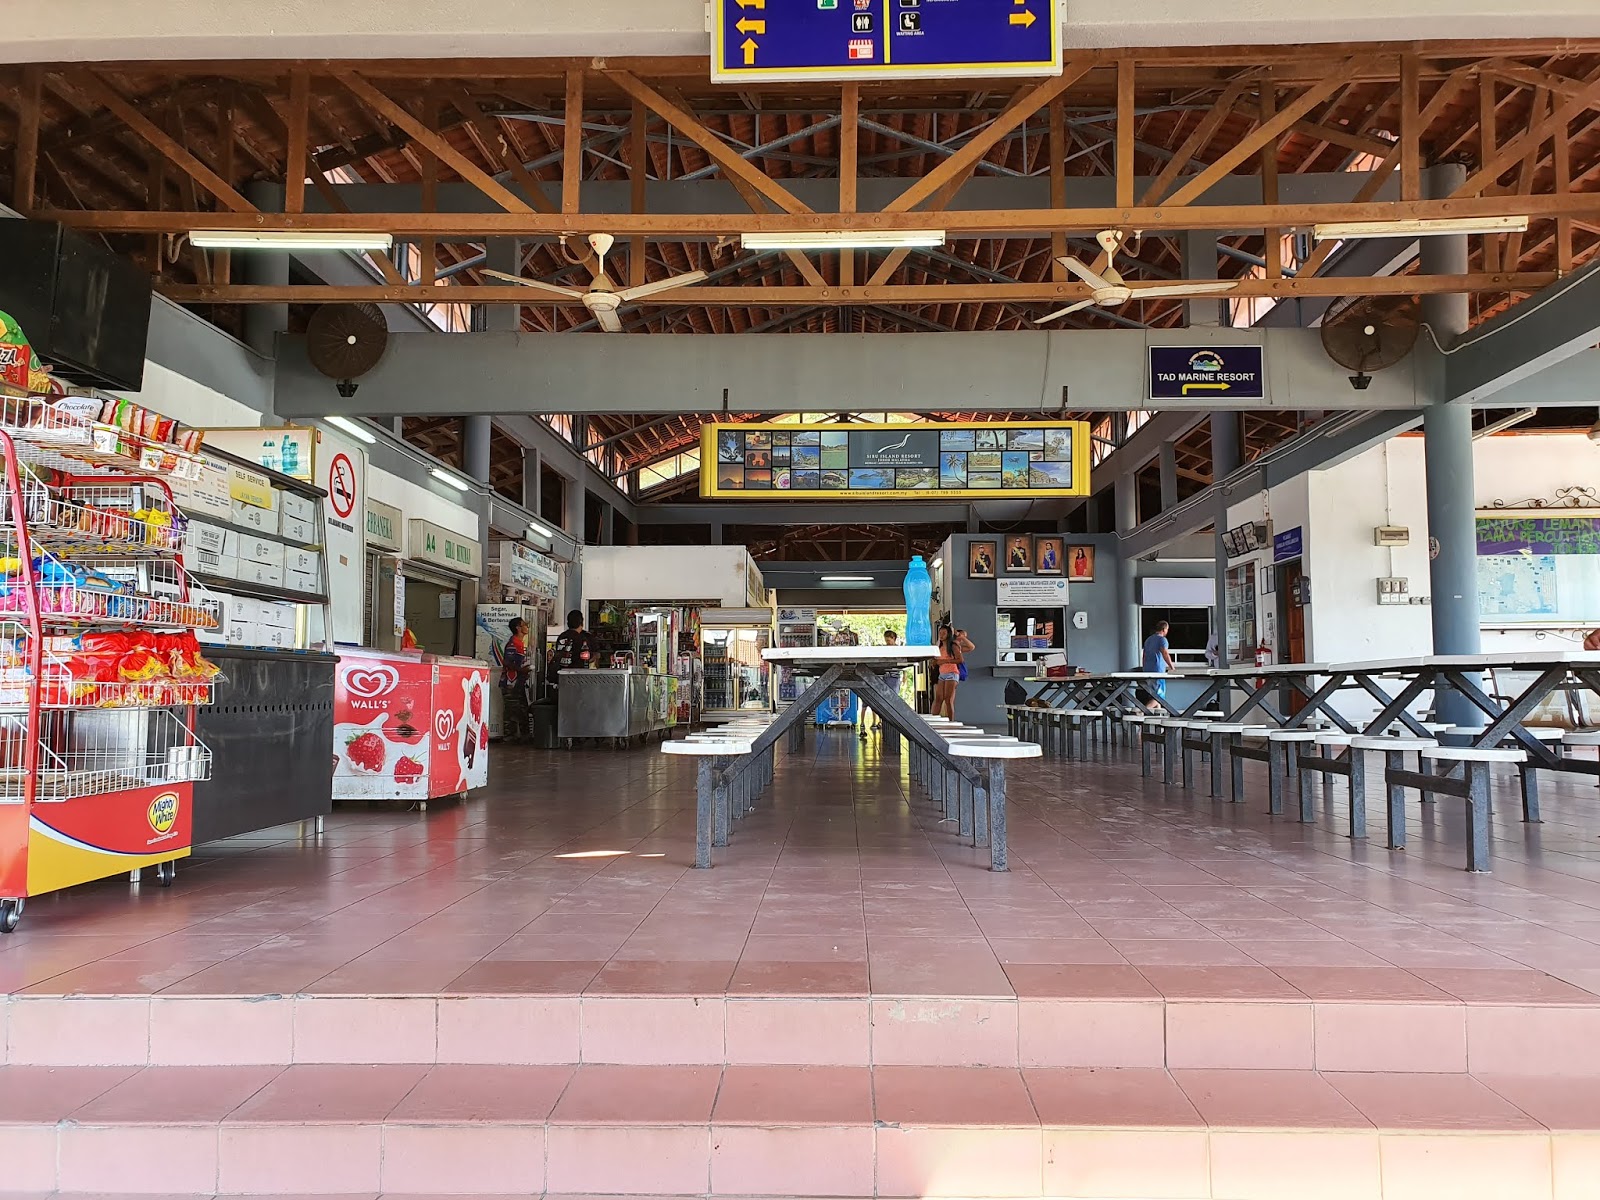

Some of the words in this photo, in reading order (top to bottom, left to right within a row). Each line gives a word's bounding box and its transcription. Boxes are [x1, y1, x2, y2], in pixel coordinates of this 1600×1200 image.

[1157, 373, 1176, 381] TAD
[1178, 373, 1215, 381] MARINE
[1217, 373, 1255, 381] RESORT
[57, 402, 95, 411] Chocolate
[235, 470, 246, 480] SELF
[247, 474, 265, 487] SERVICE
[426, 532, 436, 554] A4
[351, 699, 389, 709] WALL'S
[152, 798, 175, 816] Mighty
[155, 810, 174, 826] White
